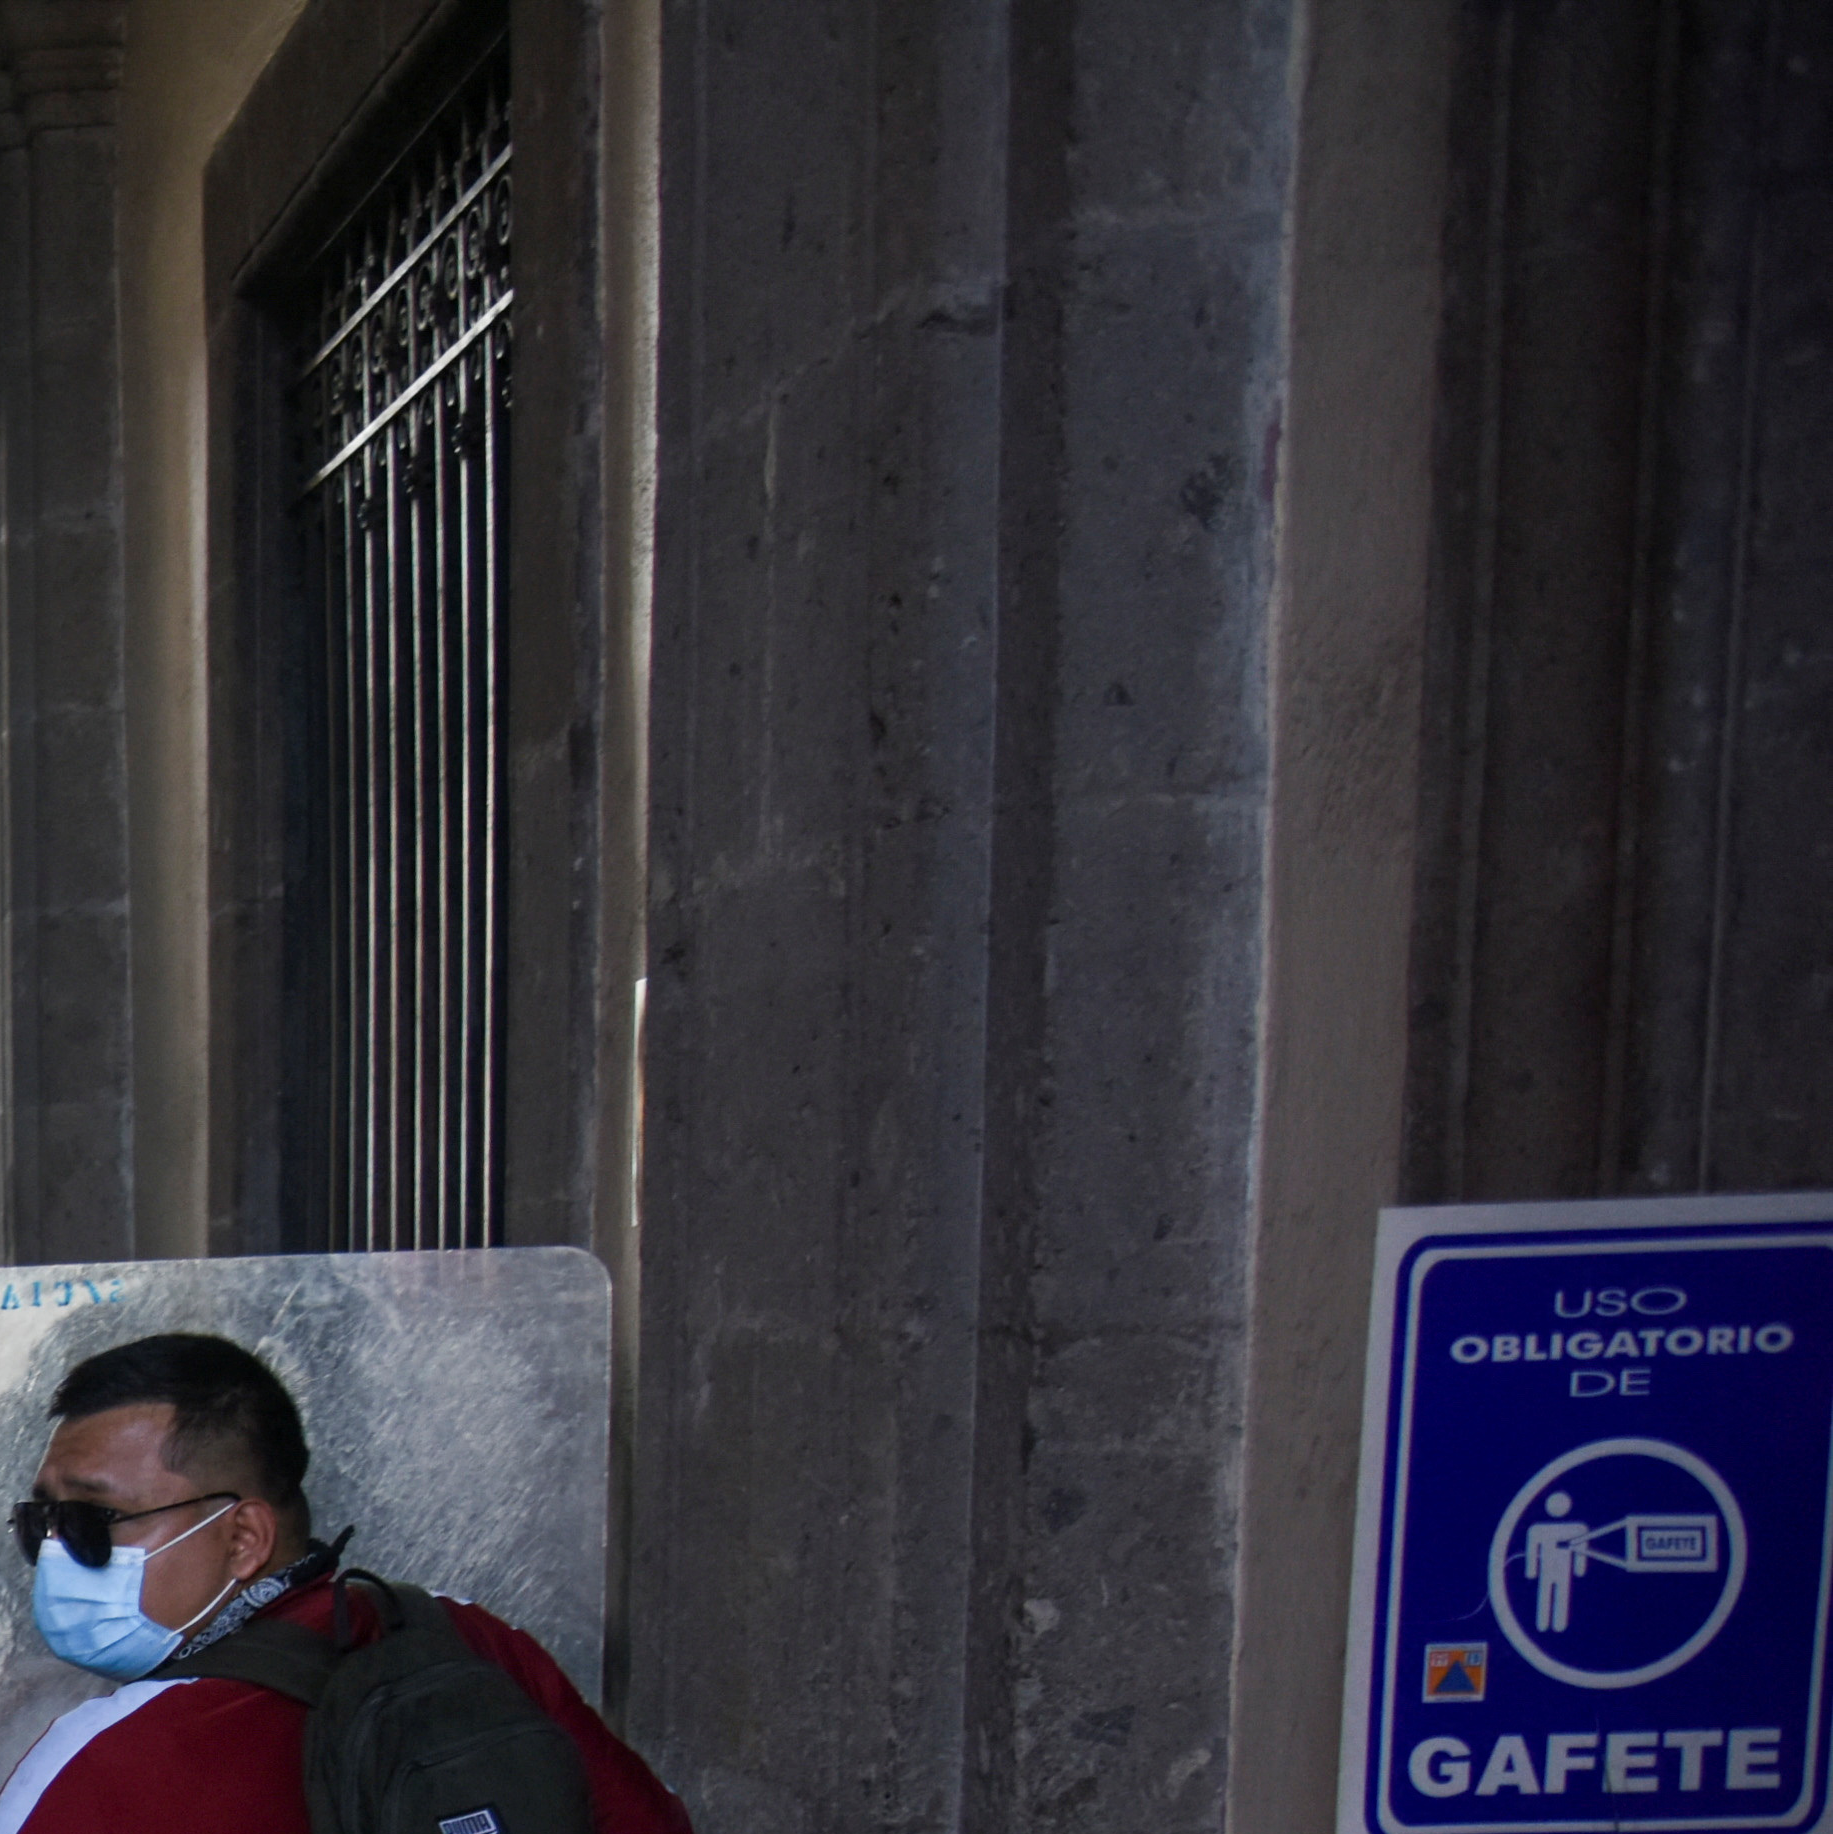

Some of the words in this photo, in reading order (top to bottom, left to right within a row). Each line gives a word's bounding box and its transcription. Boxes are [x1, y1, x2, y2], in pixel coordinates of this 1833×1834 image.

[1553, 1286, 1687, 1319] USO
[1449, 1323, 1795, 1363] OBLIGATORIO
[1569, 1367, 1652, 1397] DE
[1643, 1533, 1698, 1553] GAFETE
[1407, 1726, 1783, 1799] GAFETE
